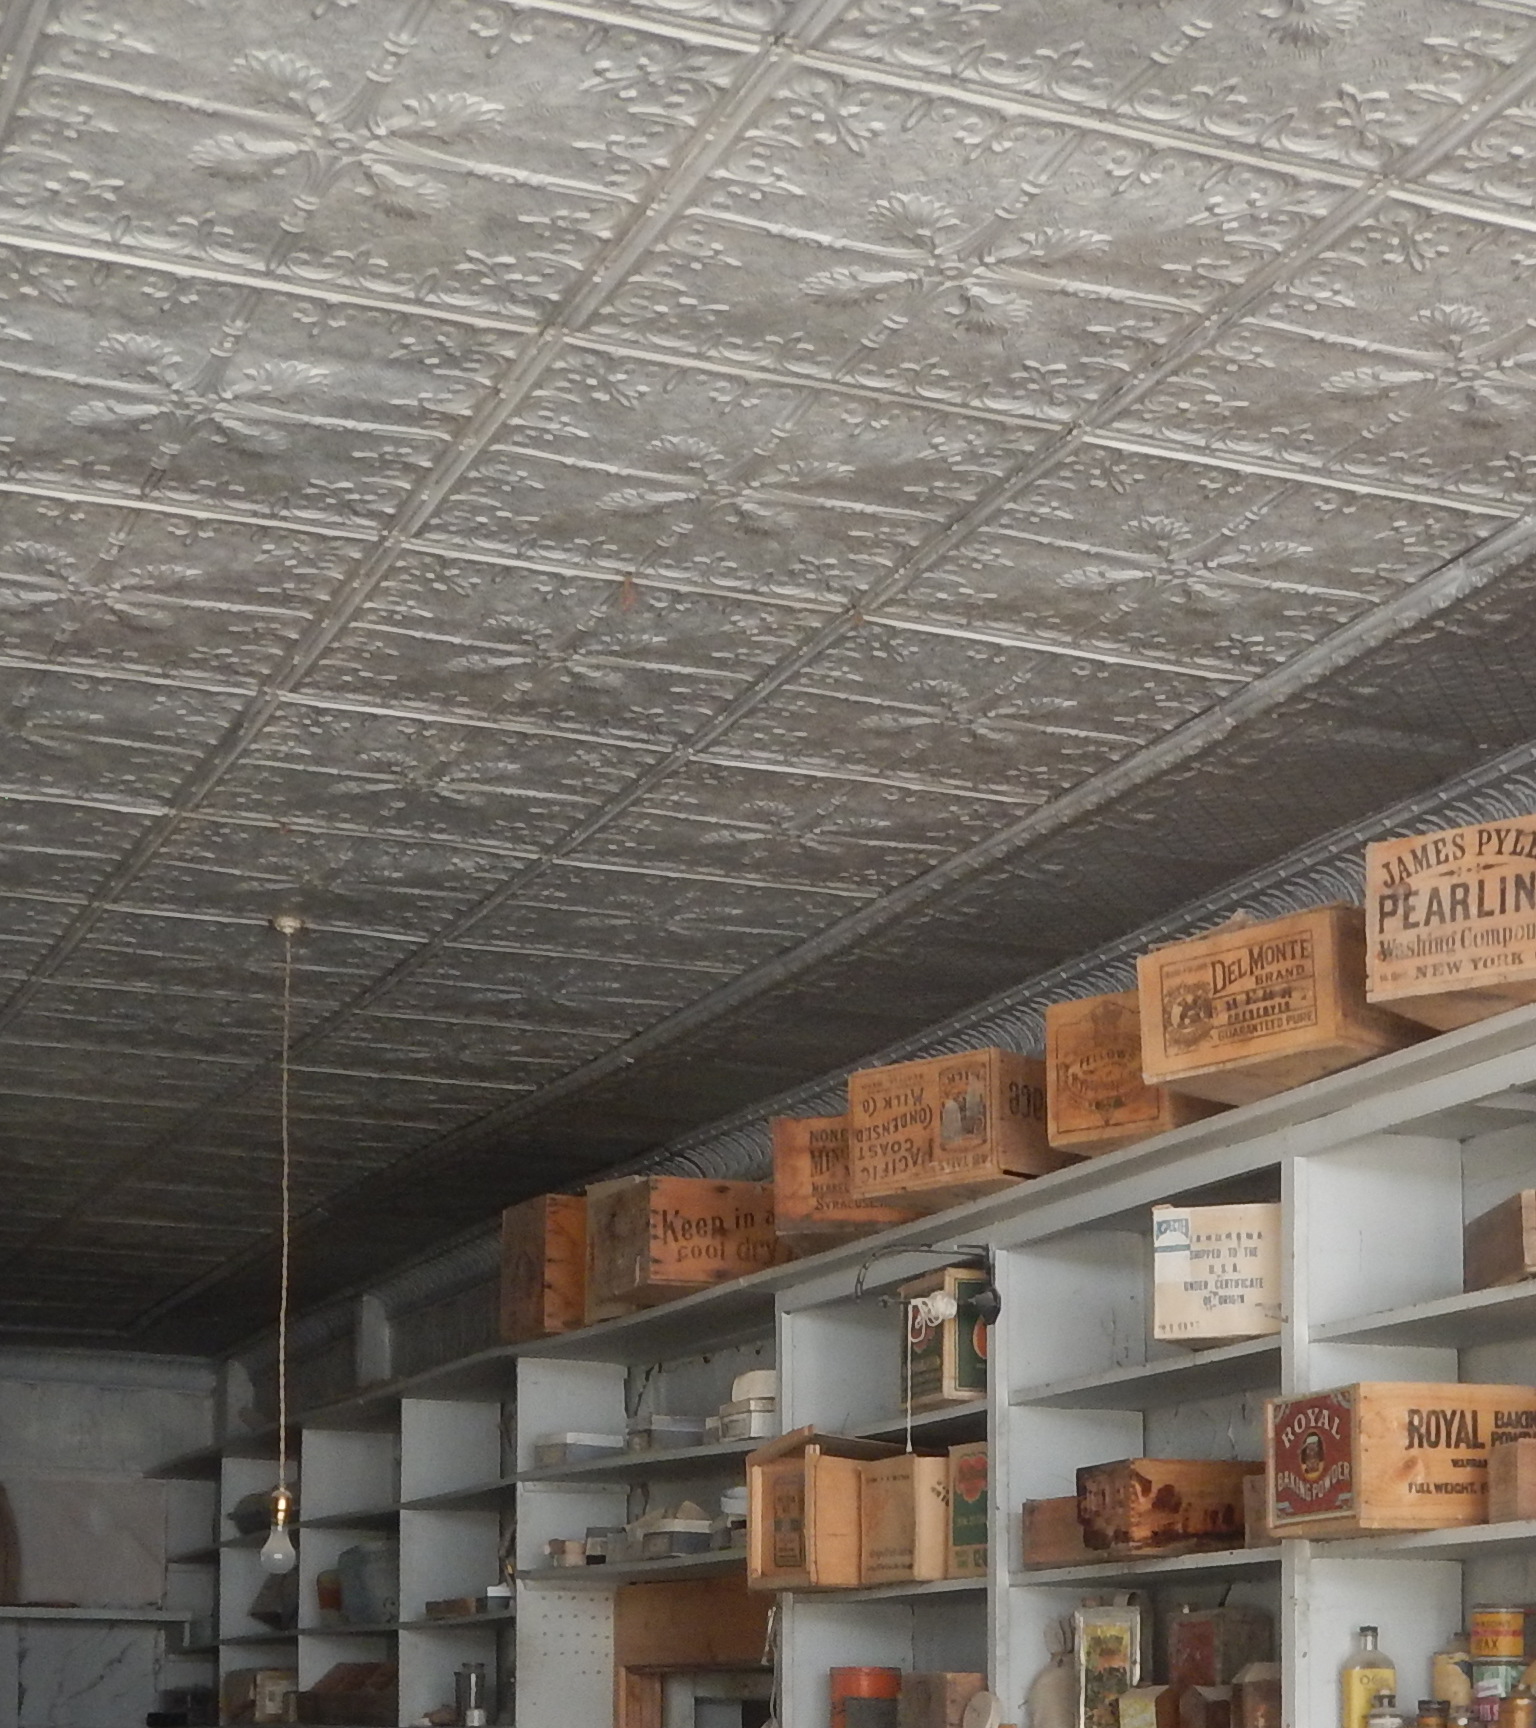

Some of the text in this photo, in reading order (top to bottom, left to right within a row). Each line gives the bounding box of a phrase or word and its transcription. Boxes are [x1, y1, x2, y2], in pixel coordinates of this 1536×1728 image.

[1381, 833, 1466, 889] JAMES
[1378, 928, 1458, 962] Washing
[1254, 964, 1306, 986] BRAND
[1414, 959, 1463, 980] NEW
[1471, 951, 1524, 971] YORK
[883, 1086, 924, 1110] MILK
[856, 1104, 934, 1144] CONDENSED
[857, 1137, 915, 1161] COAST
[663, 1208, 728, 1245] Keep
[734, 1207, 755, 1230] in
[676, 1241, 726, 1263] cool
[1227, 1246, 1238, 1259] TO
[1244, 1246, 1259, 1259] THE
[1214, 1277, 1264, 1290] CERTIFICATE
[1281, 1406, 1344, 1449] ROYAL
[1405, 1408, 1486, 1450] ROYAL
[1277, 1461, 1351, 1502] BAKING POWDER
[1408, 1481, 1433, 1495] FULL
